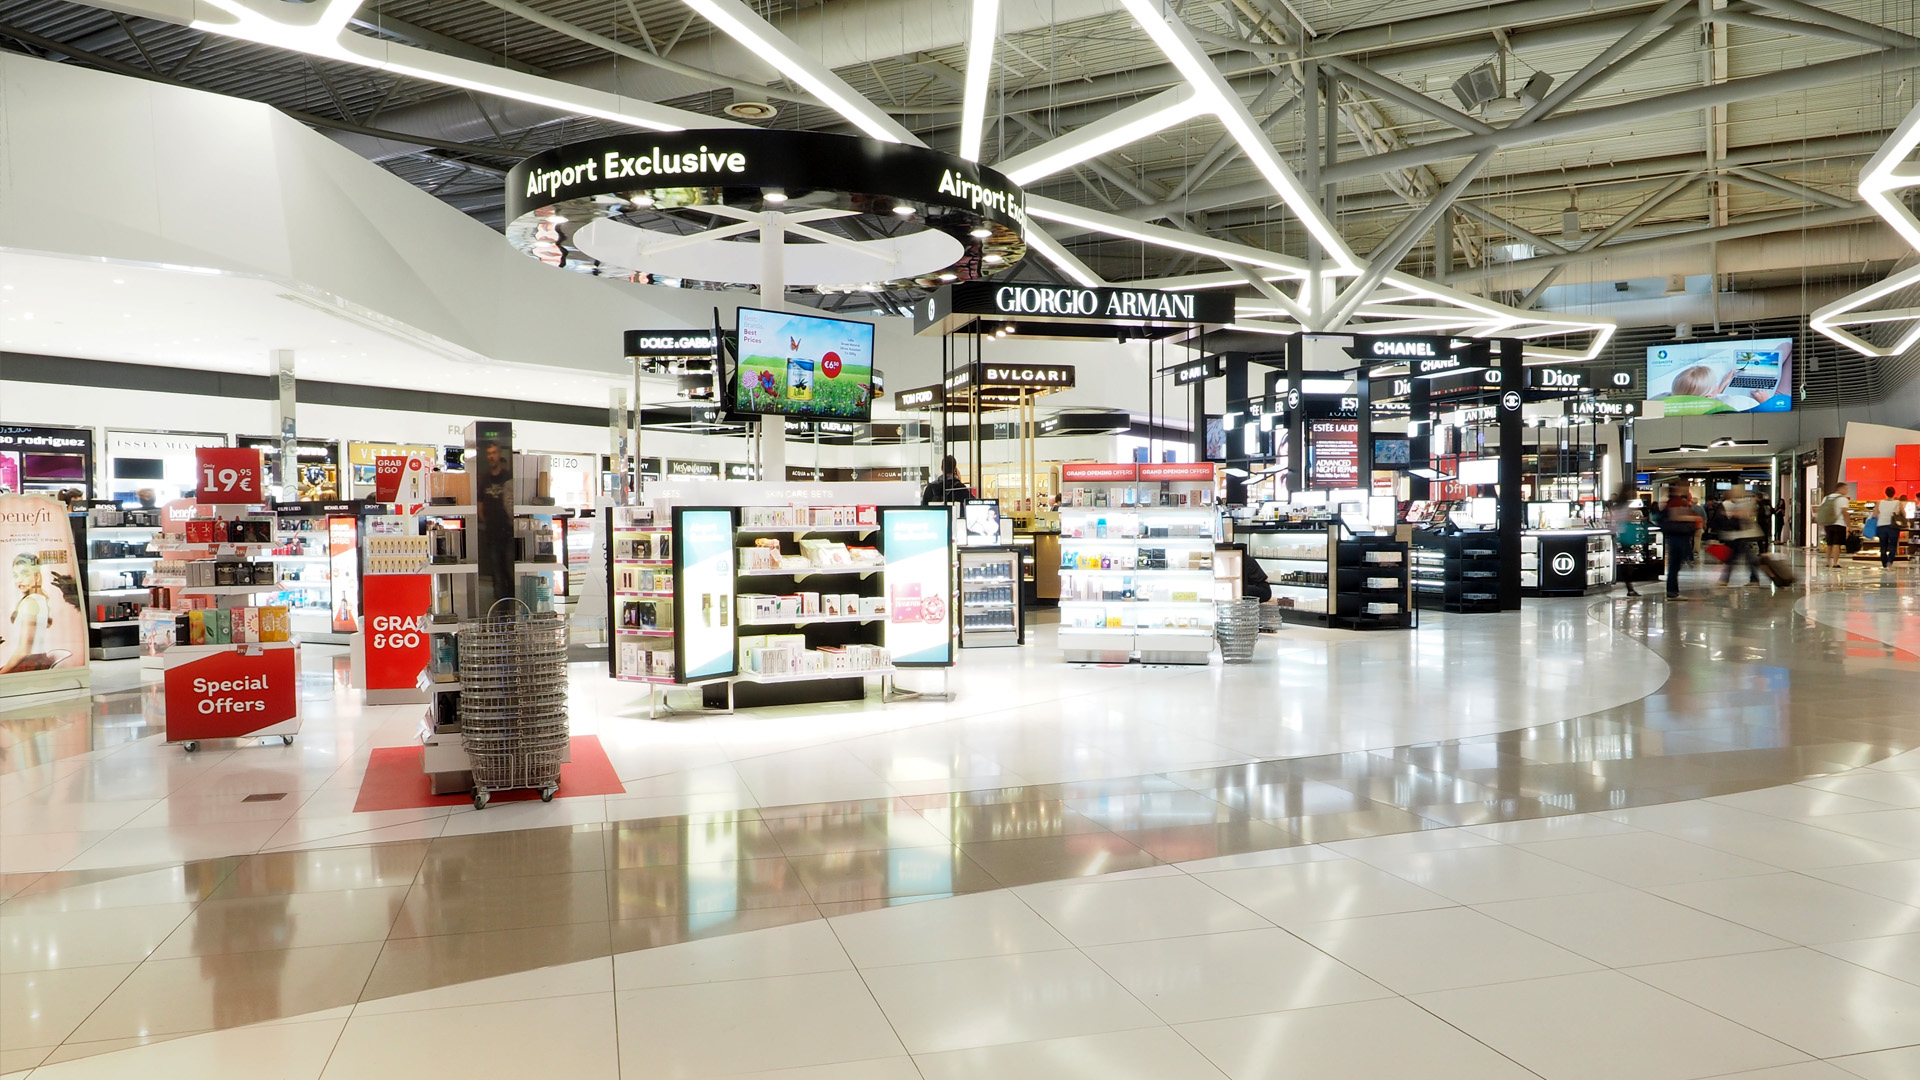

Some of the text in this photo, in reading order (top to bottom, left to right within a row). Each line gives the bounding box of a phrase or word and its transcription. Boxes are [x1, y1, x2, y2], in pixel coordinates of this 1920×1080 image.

[527, 146, 746, 197] Airport Exclusive
[938, 169, 1006, 213] Airport
[996, 286, 1195, 319] GIORGIO ARMANI
[744, 336, 762, 344] Prices
[1373, 341, 1436, 356] CHANEL
[1420, 355, 1460, 372] CHANEL
[987, 369, 1068, 382] BVLGARI
[1180, 364, 1209, 381] CHANL
[1542, 369, 1581, 386] Dior
[902, 391, 933, 405] TOM FORD
[821, 421, 852, 432] GUERLAIN
[17, 436, 86, 447] rodriguez
[117, 440, 159, 448] ISSEY
[378, 459, 402, 467] GRAB
[550, 458, 578, 468] ENZO
[1315, 459, 1351, 467] ADVANCED
[169, 505, 197, 521] benefit
[374, 633, 420, 648] & GO
[193, 674, 269, 697] Special
[198, 698, 266, 714] Offers
